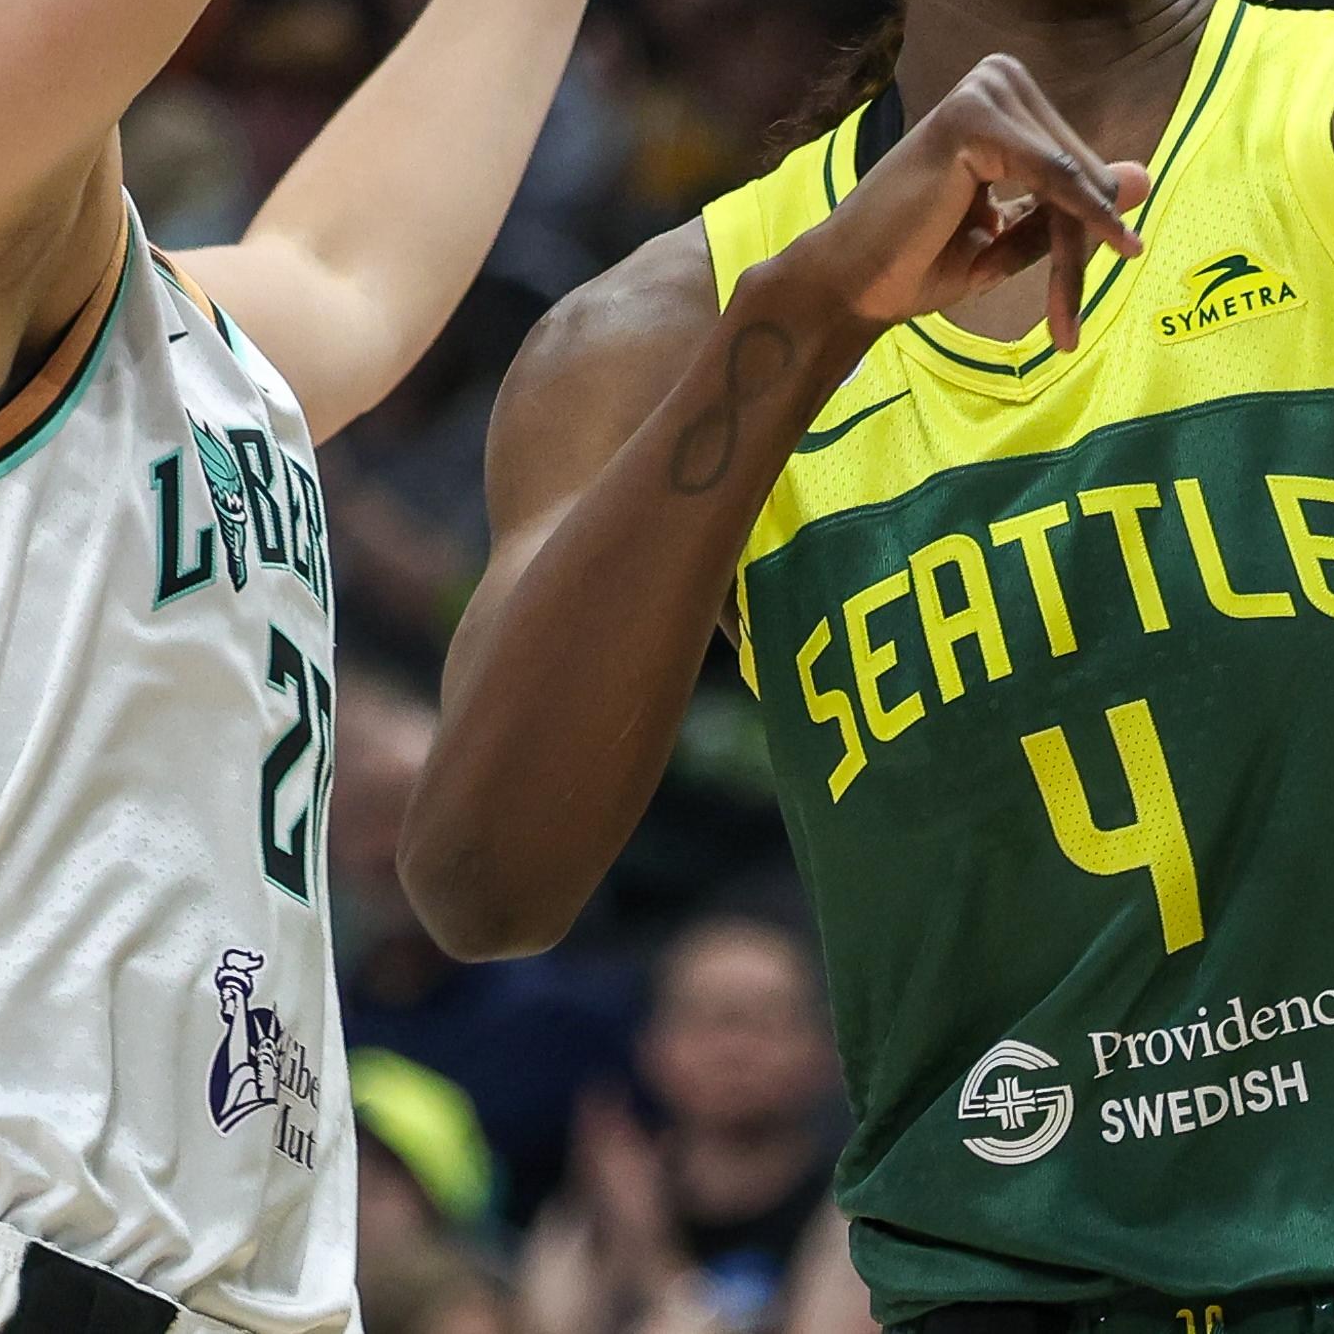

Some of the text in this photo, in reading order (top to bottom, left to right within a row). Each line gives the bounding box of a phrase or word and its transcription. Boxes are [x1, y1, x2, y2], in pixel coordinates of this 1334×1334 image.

[1160, 281, 1298, 336] SYMETRA
[1019, 699, 1205, 955] 4
[1099, 1060, 1310, 1145] SWEDISH
